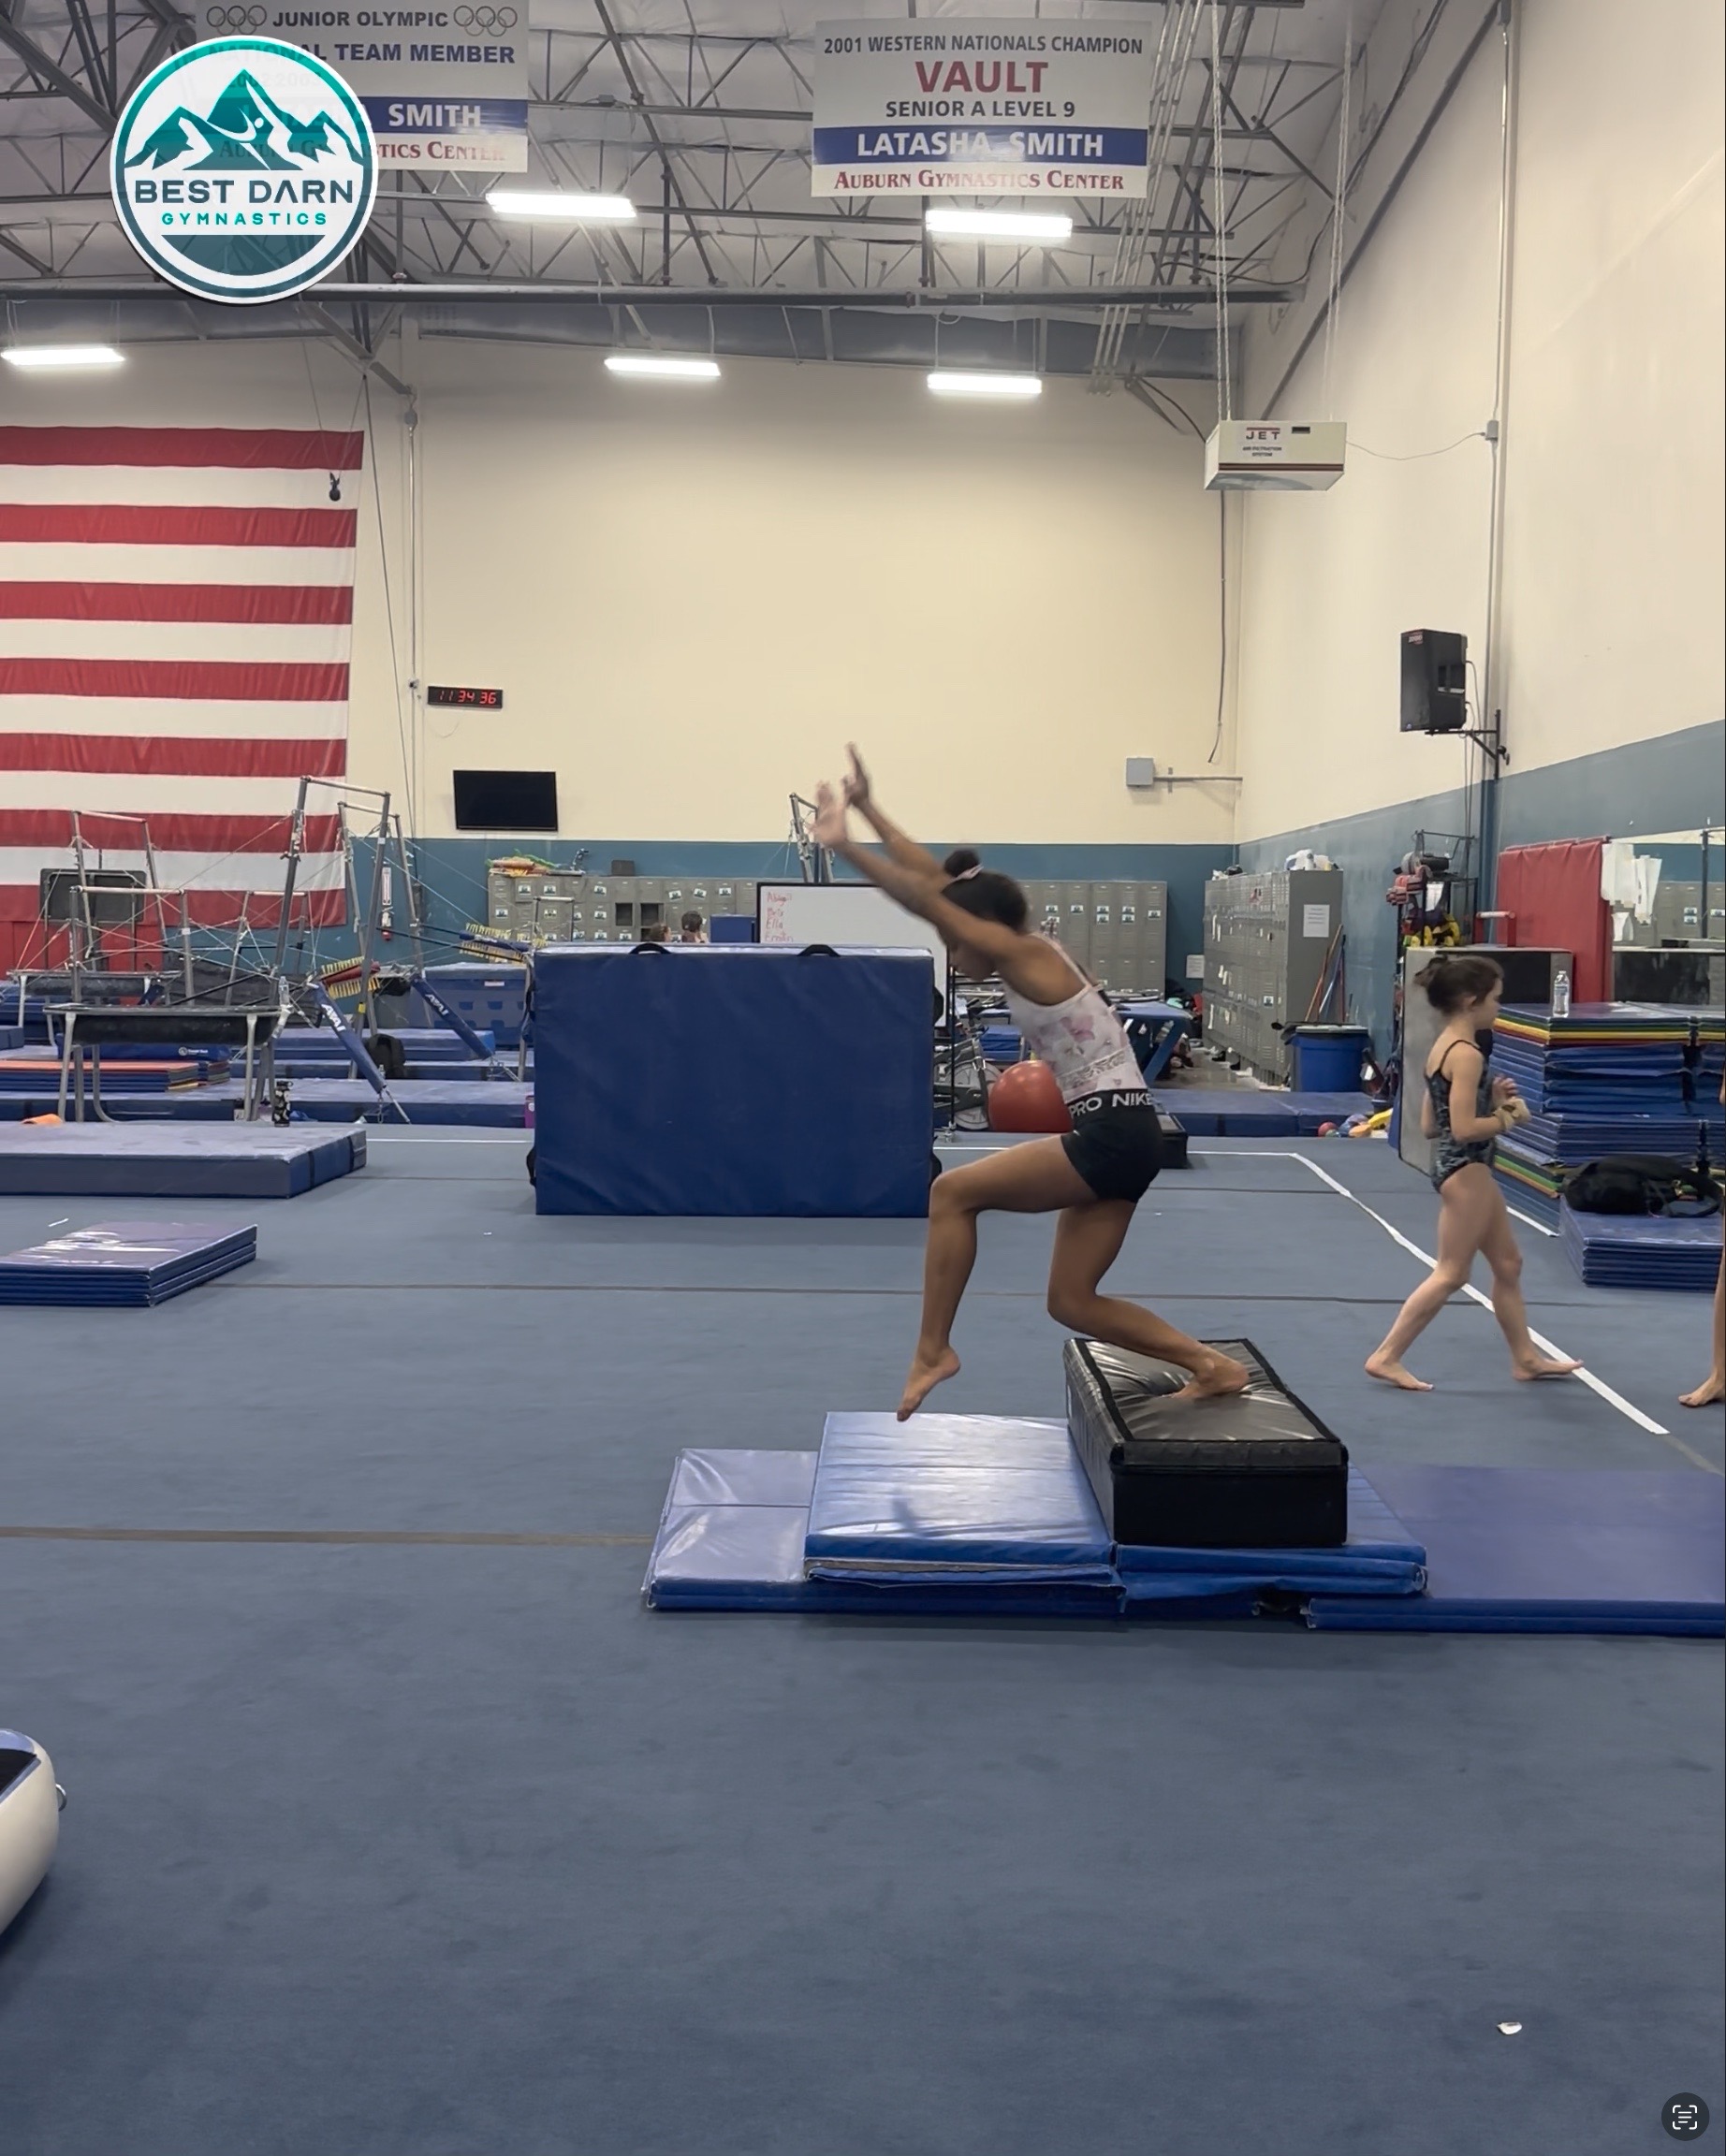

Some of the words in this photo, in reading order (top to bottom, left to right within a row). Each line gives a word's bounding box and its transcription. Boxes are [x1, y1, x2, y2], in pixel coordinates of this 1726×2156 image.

[272, 11, 350, 27] JUNIOR
[357, 11, 448, 27] OLYMPIC
[334, 44, 402, 61] TEAM
[410, 44, 516, 64] MEMBER
[824, 37, 862, 54] 2001
[868, 36, 946, 52] WESTERN
[950, 35, 1046, 51] NATIONALS
[1052, 36, 1143, 54] CHAMPION
[915, 61, 1048, 94] VAULT
[388, 103, 481, 127] SMITH
[885, 101, 965, 118] SENIOR
[971, 101, 987, 117] A
[992, 100, 1057, 117] LEVEL
[1063, 101, 1075, 118] 9
[856, 132, 992, 156] LATASHA
[1008, 131, 1104, 157] SMITH
[834, 171, 912, 190] AUBURN
[917, 169, 1041, 188] GYMNASTICS
[1046, 169, 1124, 190] CENTER
[1245, 431, 1280, 440] JET
[1069, 1097, 1103, 1119] PRO
[1111, 1093, 1153, 1108] NIKE
